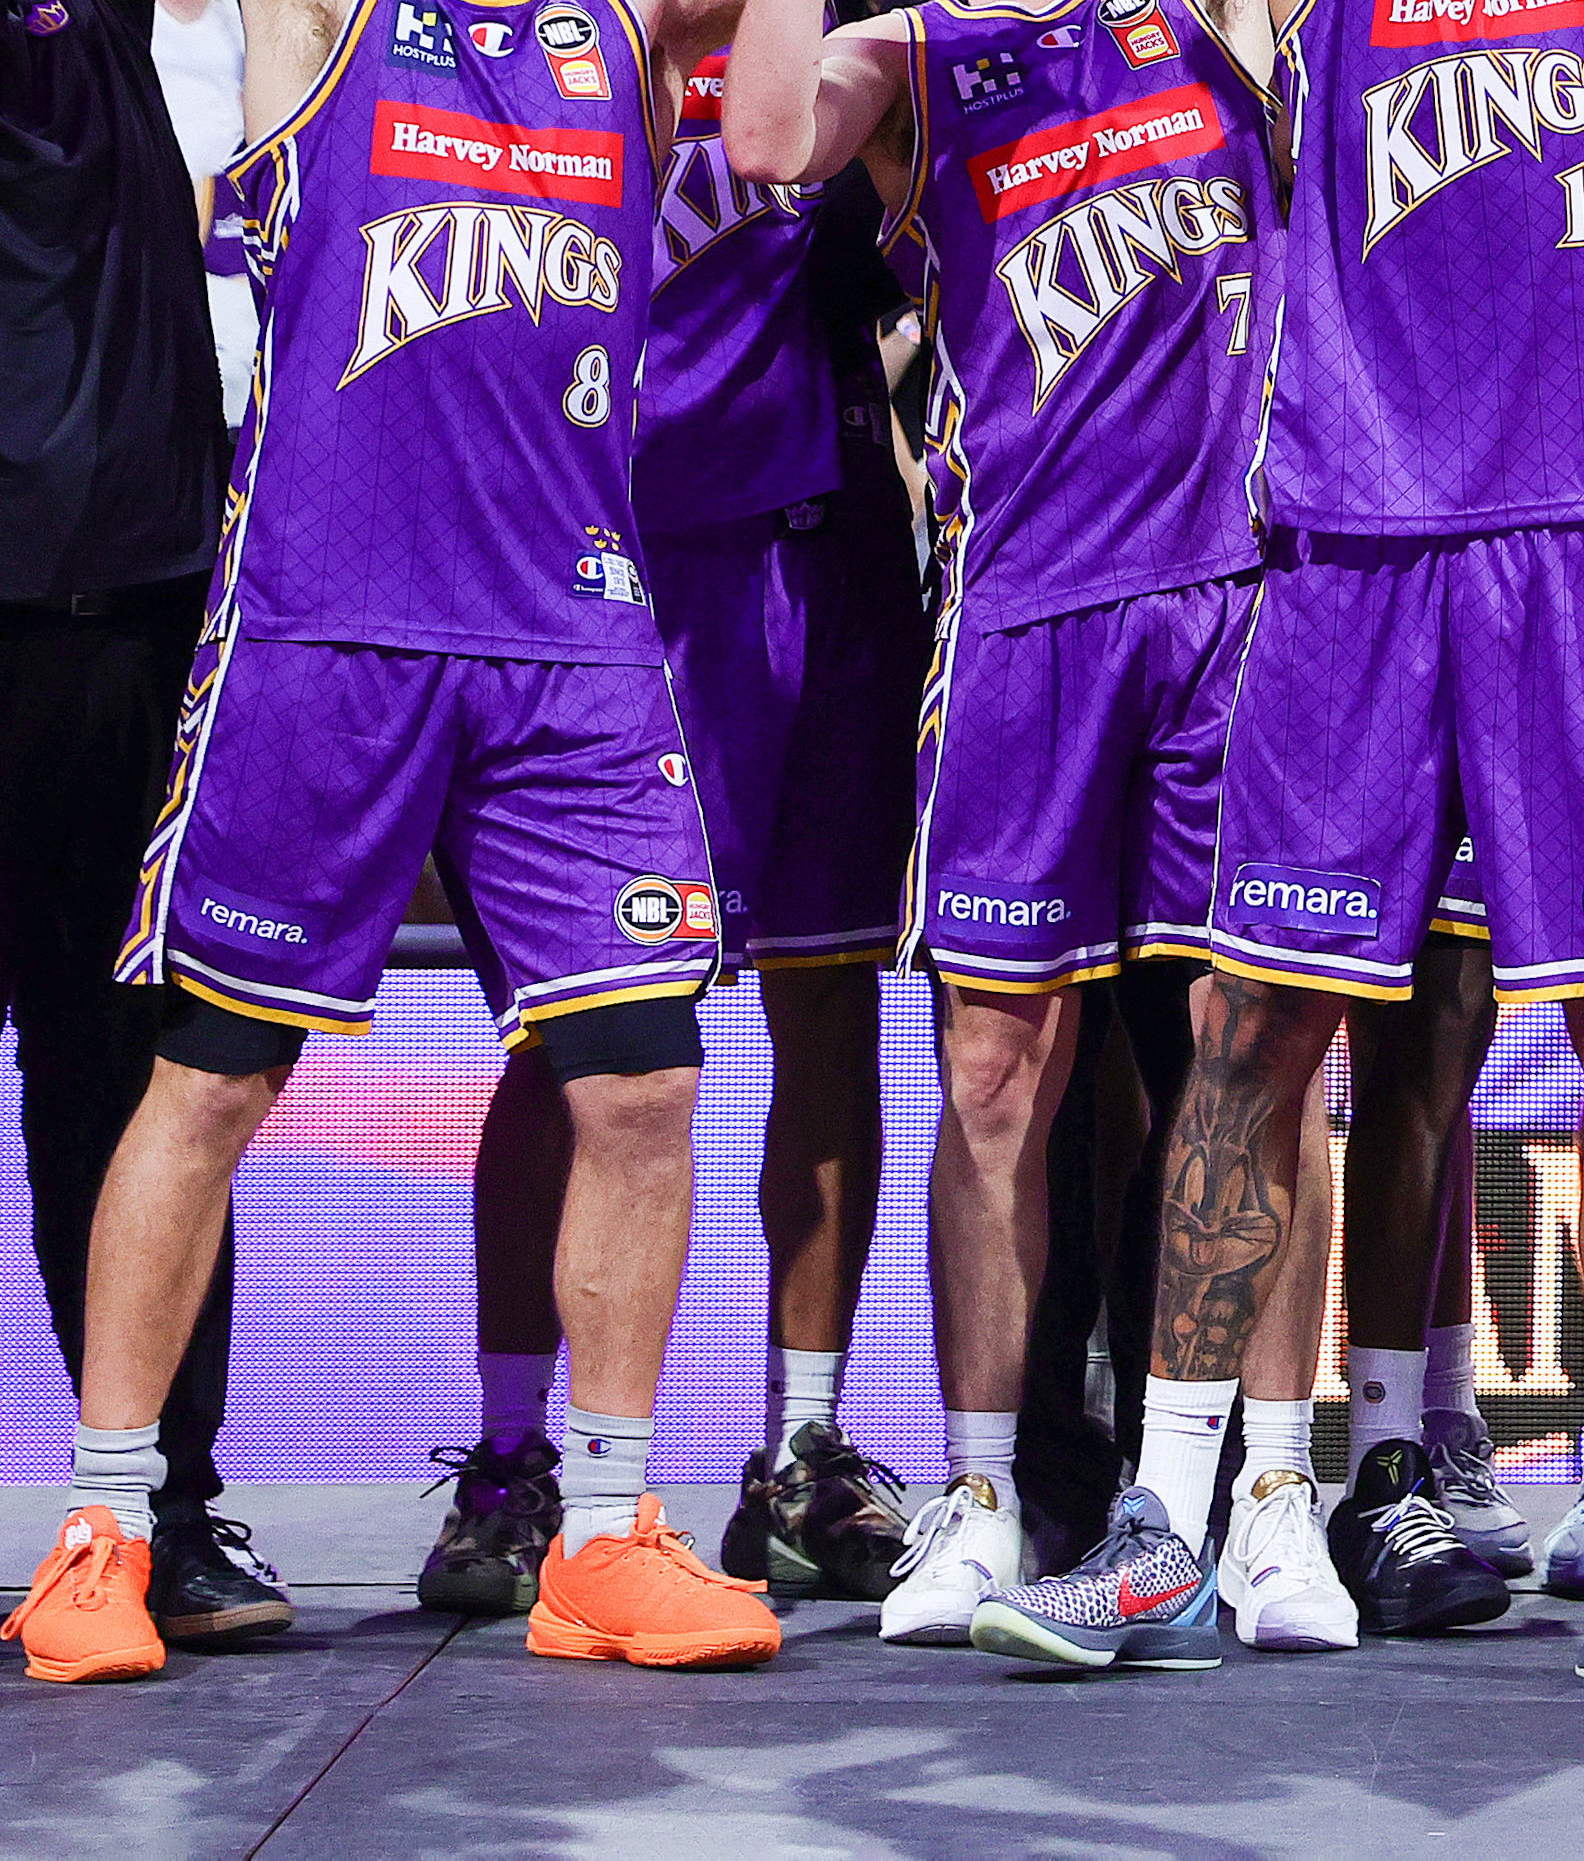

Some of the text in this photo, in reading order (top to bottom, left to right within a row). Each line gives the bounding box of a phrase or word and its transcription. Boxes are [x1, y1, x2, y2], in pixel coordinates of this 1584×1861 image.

[393, 44, 457, 68] HOSTPLUS
[543, 21, 583, 47] NBL
[965, 87, 1024, 114] HOSTPLUS
[391, 122, 612, 180] Harvey Norman
[987, 107, 1205, 195] Harvey Norman
[337, 201, 622, 391] KINGS
[995, 177, 1249, 416] KINGS
[1217, 273, 1253, 356] 7
[562, 344, 612, 428] 8
[200, 897, 309, 944] remara.
[631, 896, 671, 924] NBL
[937, 887, 1072, 928] remara.
[1229, 878, 1378, 921] remara.
